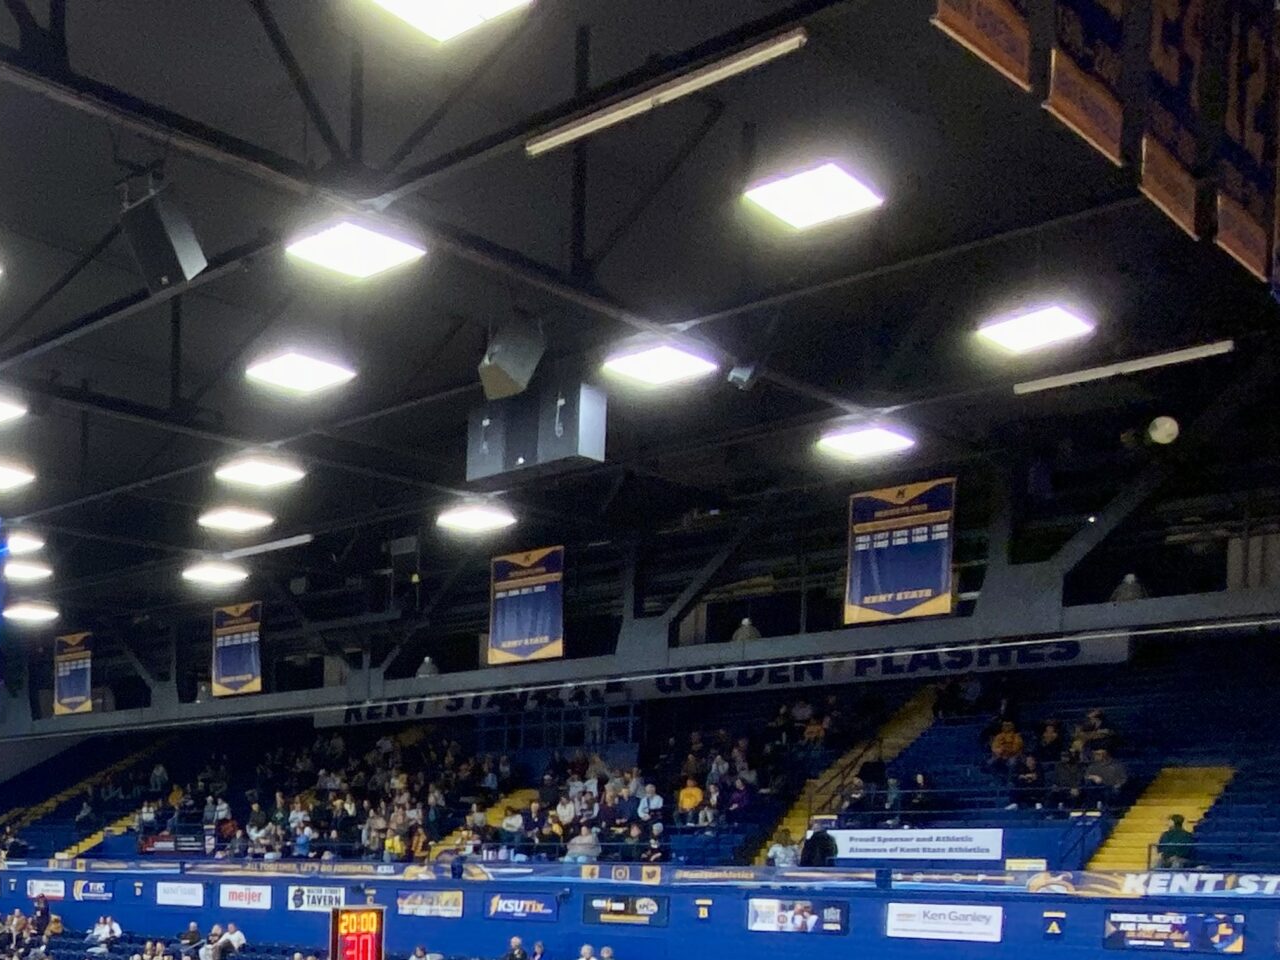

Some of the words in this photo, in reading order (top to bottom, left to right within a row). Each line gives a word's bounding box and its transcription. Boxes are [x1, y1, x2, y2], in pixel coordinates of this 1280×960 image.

[1122, 873, 1224, 894] KENT
[228, 888, 263, 905] meijer
[306, 894, 341, 907] TAVERN
[340, 912, 377, 933] 20:00
[922, 909, 946, 921] Ken
[948, 910, 992, 926] Ganley
[1046, 921, 1062, 934] A
